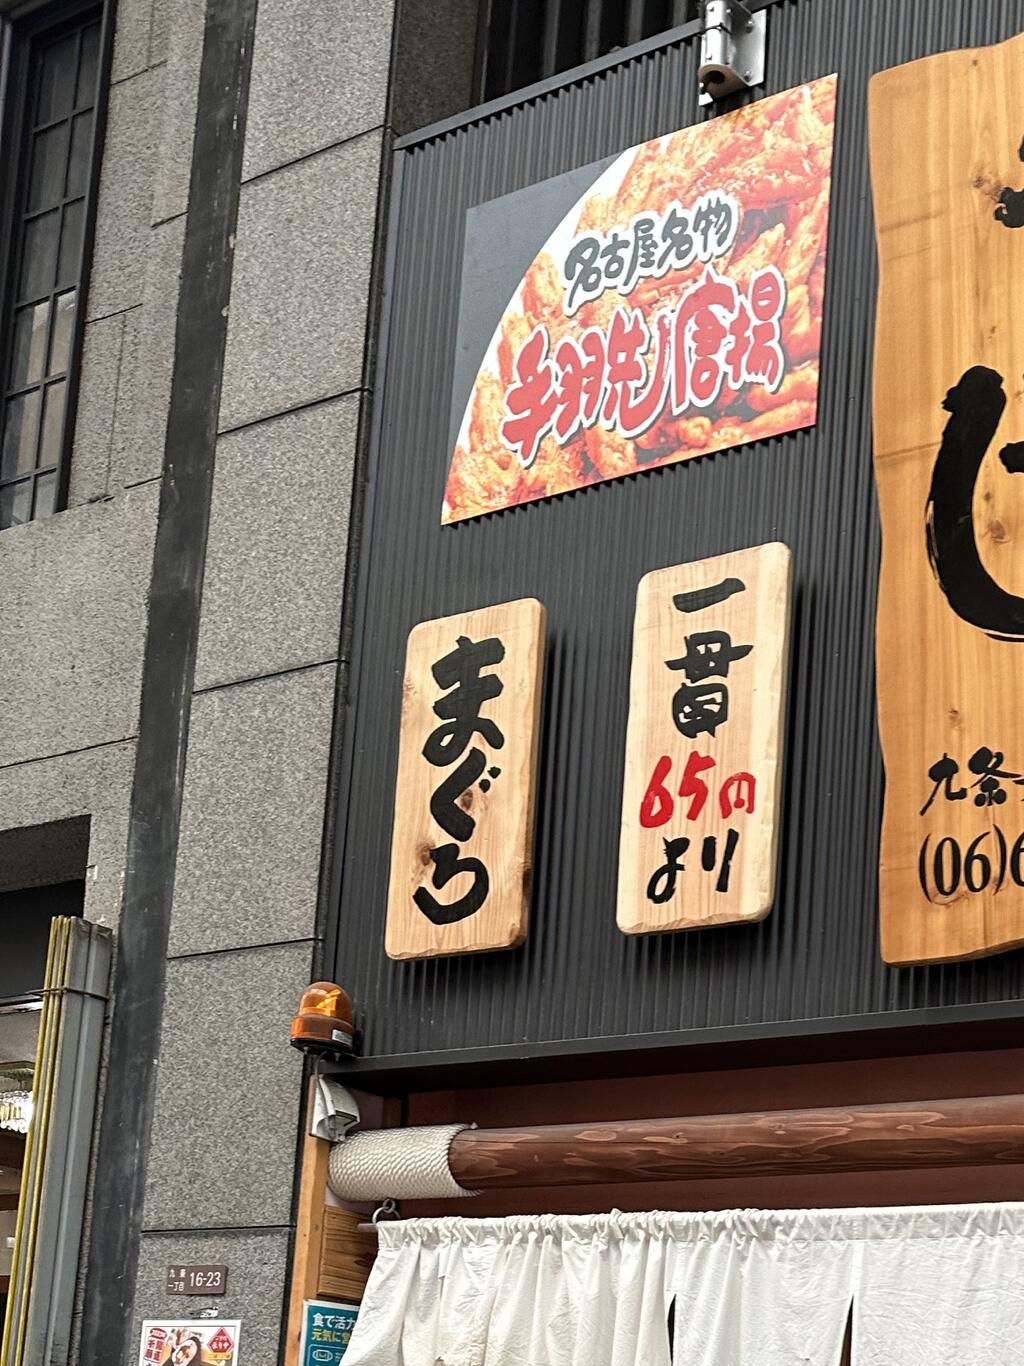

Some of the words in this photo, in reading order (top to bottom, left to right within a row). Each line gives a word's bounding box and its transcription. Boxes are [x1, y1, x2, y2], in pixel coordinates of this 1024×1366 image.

[564, 196, 733, 304] 名古屋名物
[502, 270, 785, 460] 手羽先唐揚
[664, 577, 754, 738] 一貫
[412, 635, 506, 925] まぐろ
[647, 829, 739, 904] より
[190, 1271, 221, 1287] 16-23
